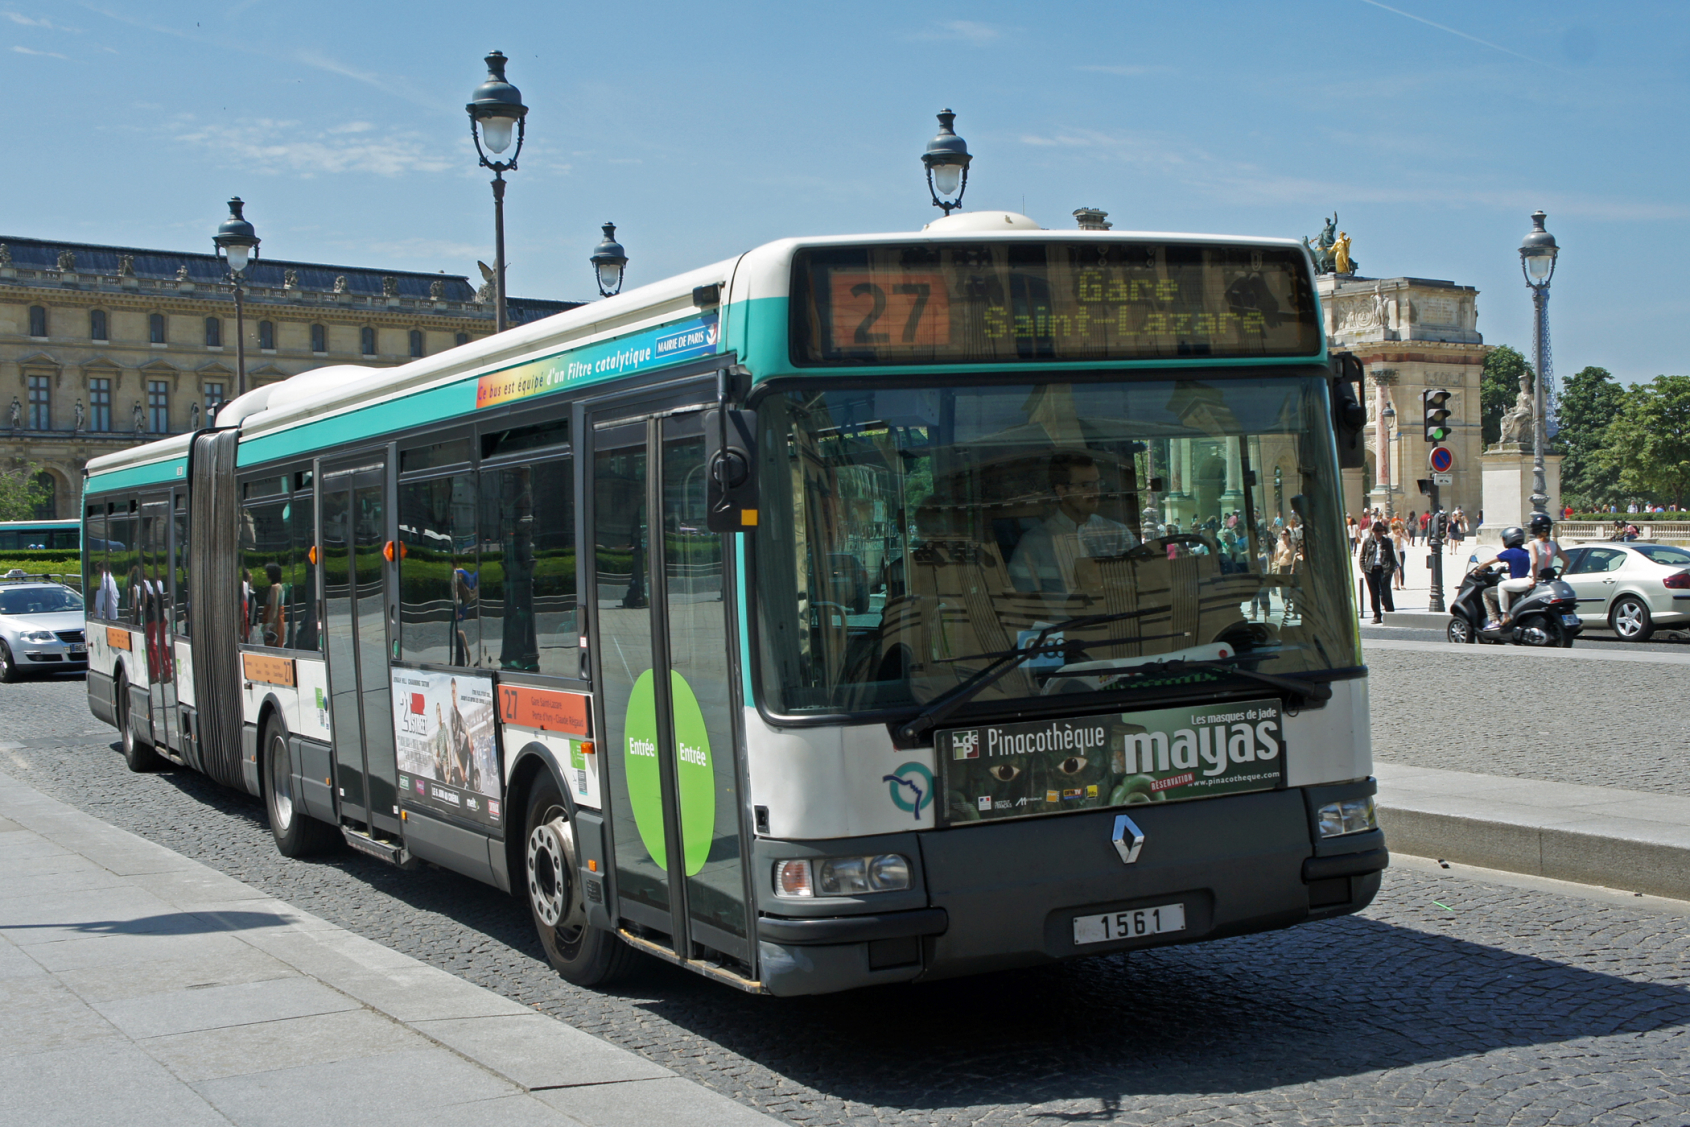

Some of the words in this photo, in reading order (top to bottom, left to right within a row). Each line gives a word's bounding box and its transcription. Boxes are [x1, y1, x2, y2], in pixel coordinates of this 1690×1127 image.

[1078, 271, 1178, 302] Gare
[852, 281, 931, 346] 27
[983, 305, 1265, 338] Saint-Lazare
[657, 338, 678, 353] MAIRIE
[678, 335, 687, 348] DE
[687, 331, 705, 346] PARIS
[478, 386, 487, 400] Ce
[489, 384, 502, 398] bus
[504, 381, 515, 395] est
[517, 372, 544, 395] équipé
[546, 367, 565, 385] d'un
[567, 361, 592, 380] Filtre
[595, 347, 651, 372] catalytique
[504, 689, 518, 720] 27
[1191, 715, 1206, 725] Les
[1207, 712, 1245, 725] masques
[1246, 709, 1257, 720] de
[1258, 707, 1277, 721] jade
[629, 737, 655, 758] Entrée
[679, 742, 707, 767] Entrée
[988, 723, 1105, 757] Pinacothèque
[1124, 720, 1279, 777] mayas
[1151, 772, 1193, 792] RÉSERVATION
[1188, 771, 1280, 787] www.pinacotheque.com
[1101, 909, 1161, 939] 1561
